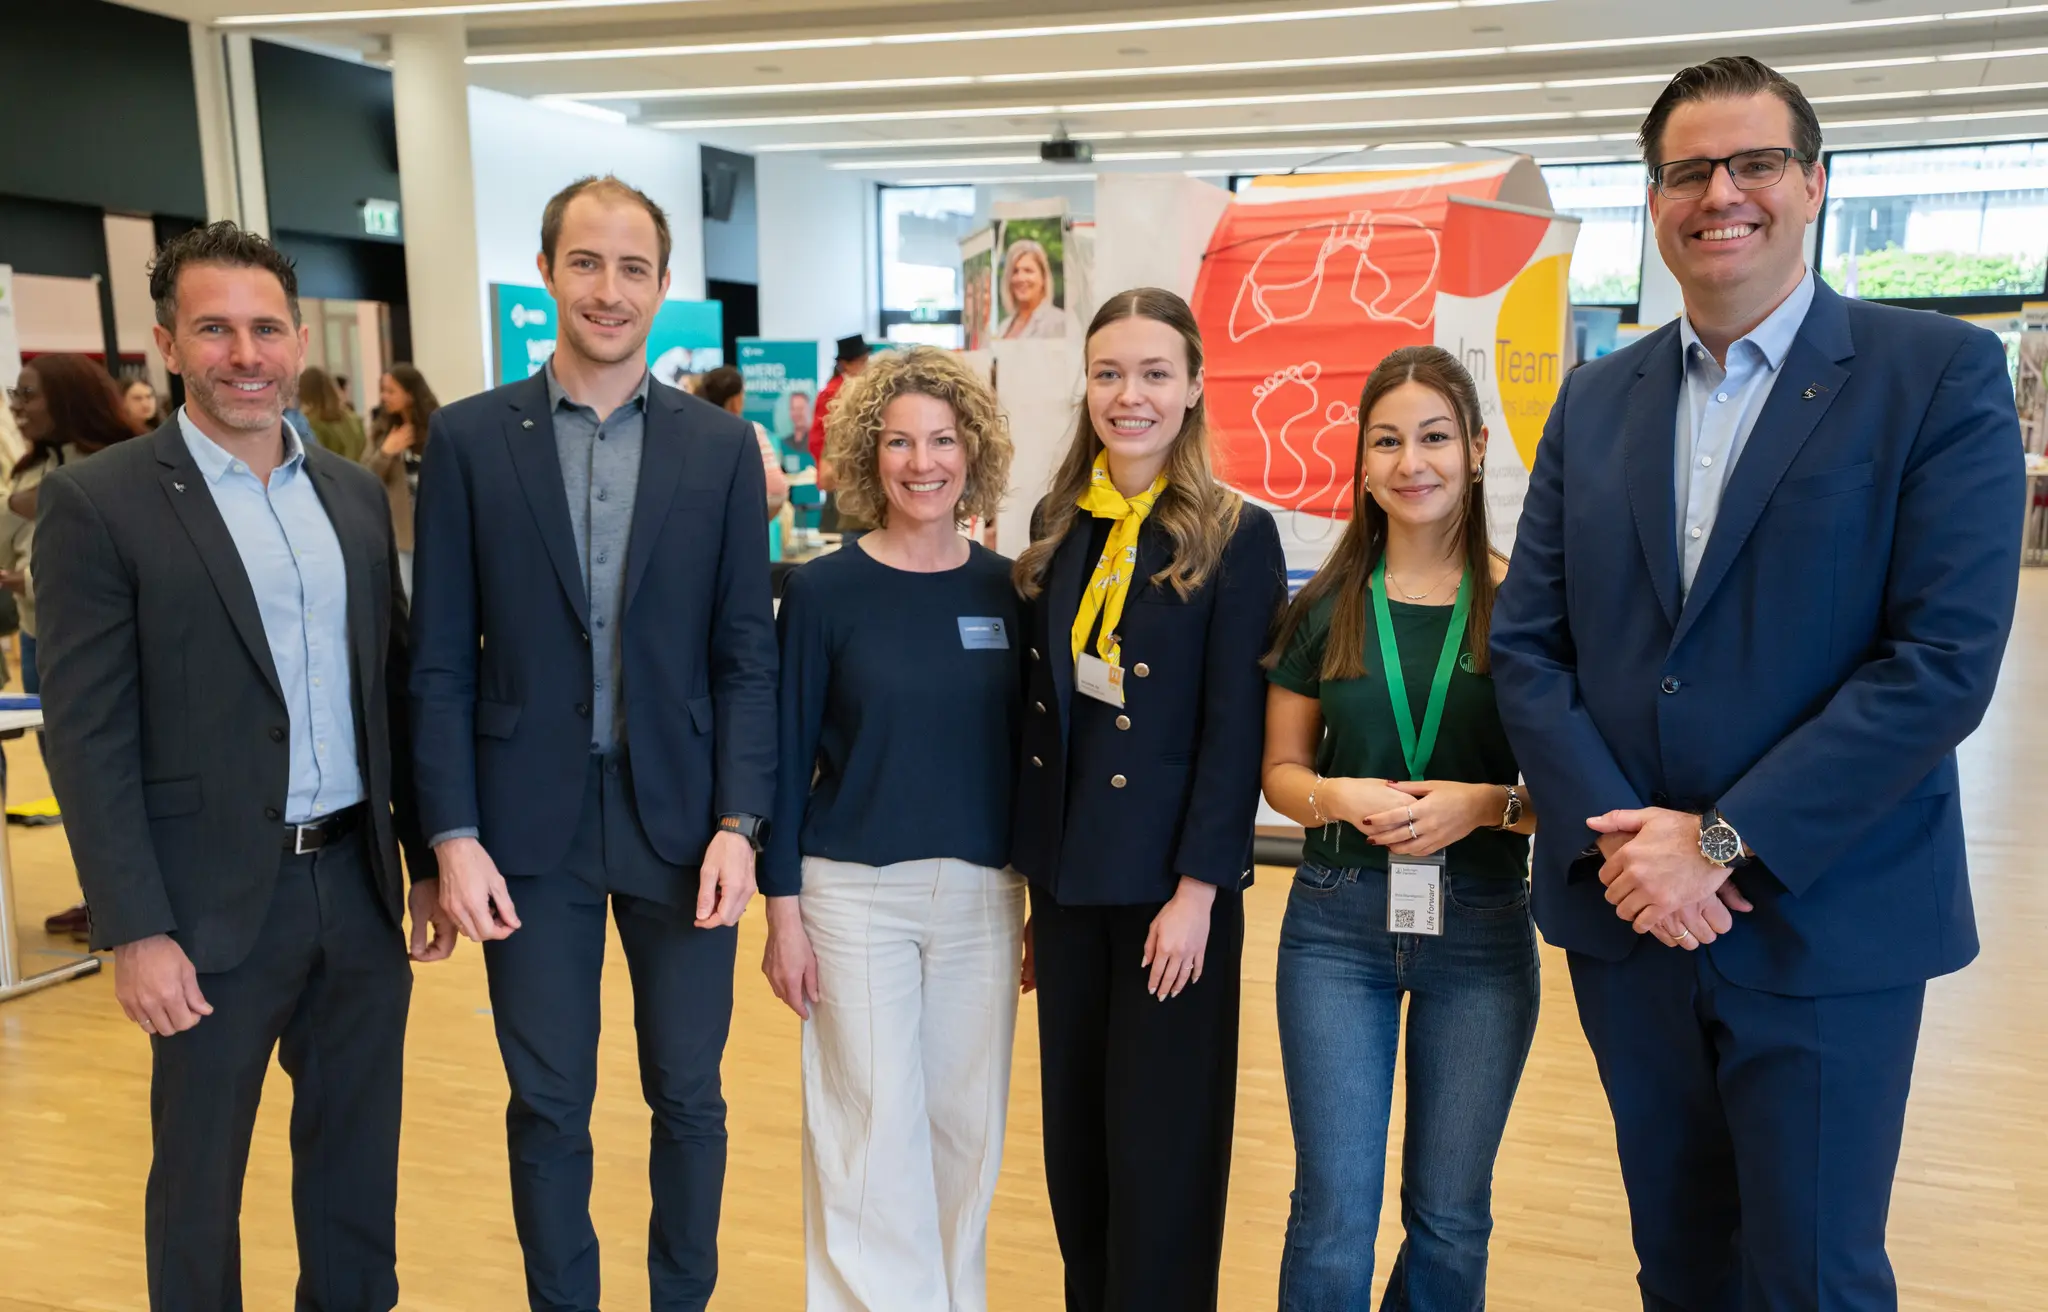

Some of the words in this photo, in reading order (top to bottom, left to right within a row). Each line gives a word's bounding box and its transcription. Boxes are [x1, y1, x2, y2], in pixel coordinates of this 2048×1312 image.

[1460, 337, 1487, 383] Im
[1495, 338, 1559, 384] Team
[1519, 396, 1553, 418] Lebe
[1426, 882, 1435, 915] forward
[1426, 916, 1435, 931] Life
